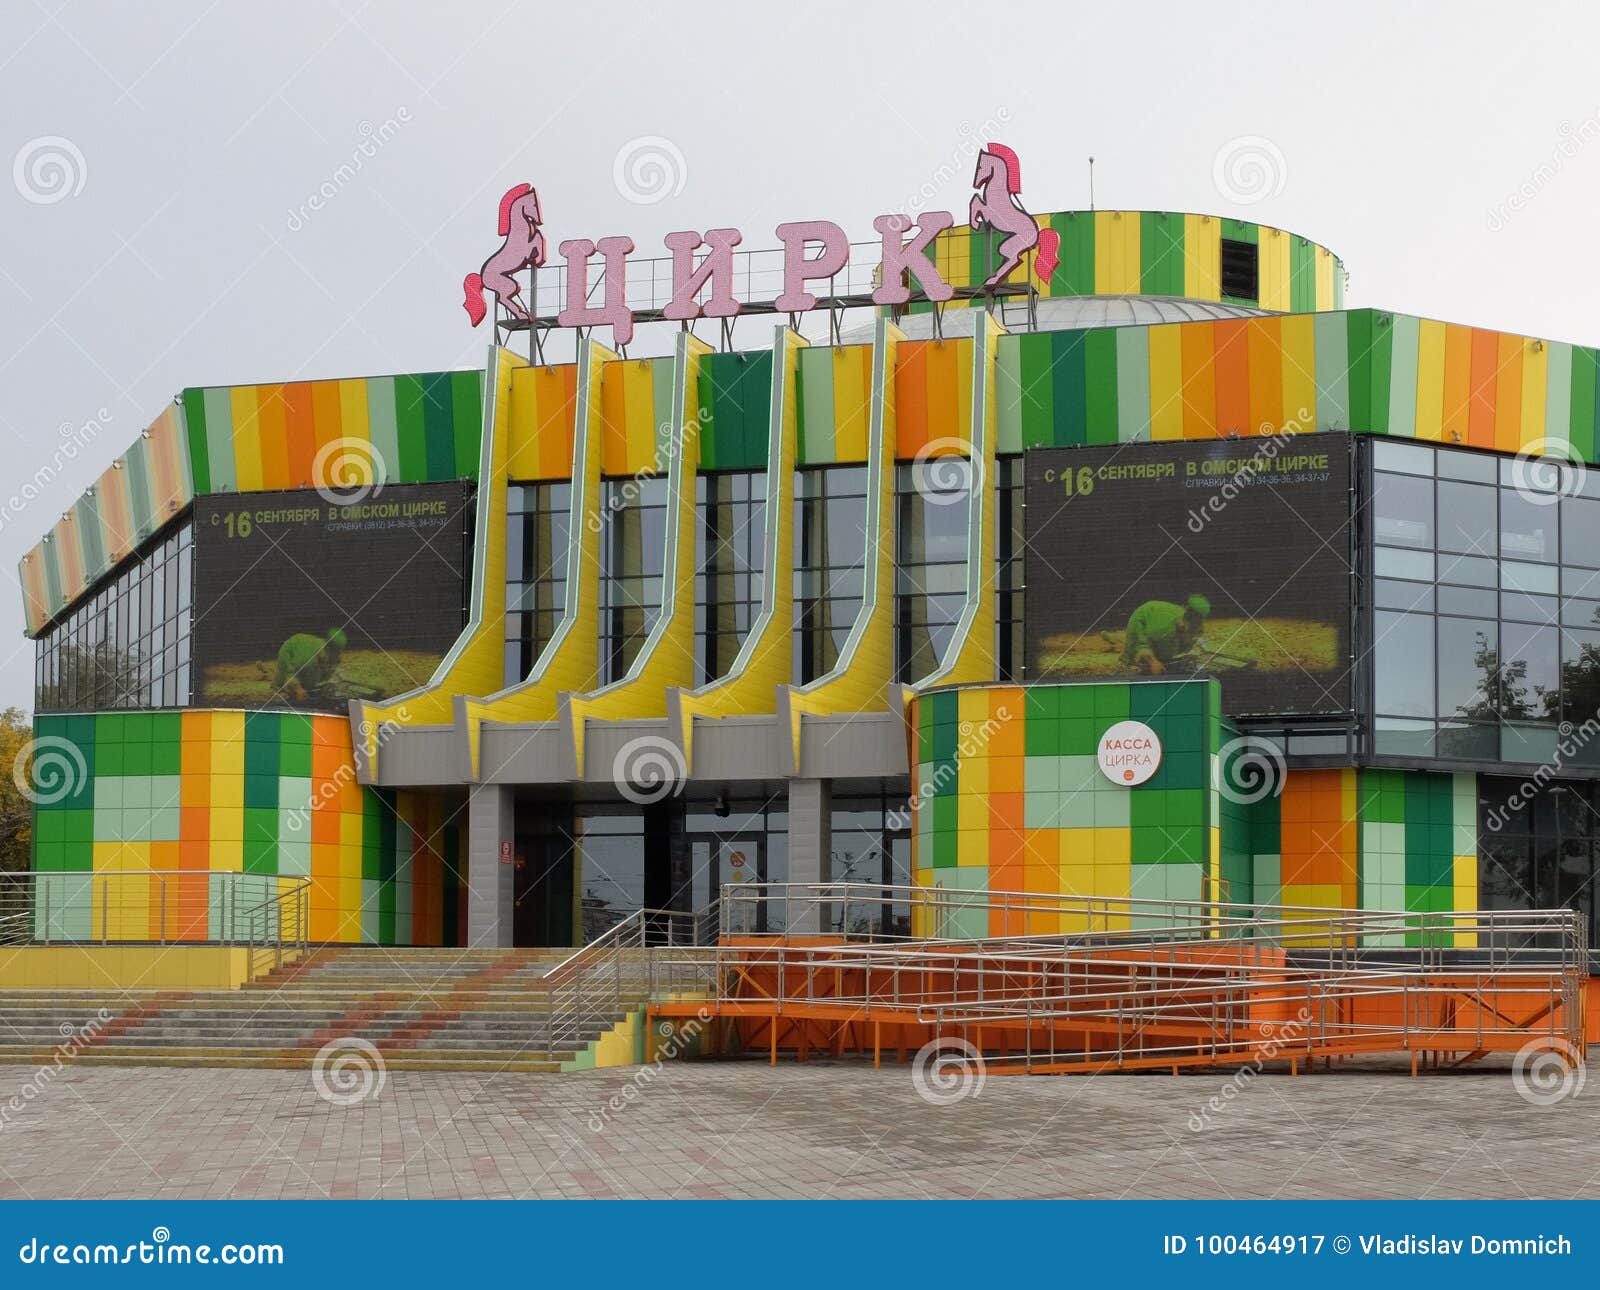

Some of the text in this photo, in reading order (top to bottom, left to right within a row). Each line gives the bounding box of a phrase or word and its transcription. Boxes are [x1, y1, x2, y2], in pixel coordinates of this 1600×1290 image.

[558, 211, 954, 346] ЦИРК
[1044, 454, 1329, 496] С 16 СЕНТЯБРЯ В ОМСКОМ ЦИРКЕ
[210, 501, 447, 538] С 16 СЕНТЯБРЯ В ОМСКОМ ЦИРКЕ
[1105, 738, 1152, 750] КАССА
[1105, 754, 1152, 767] ЦИРКА
